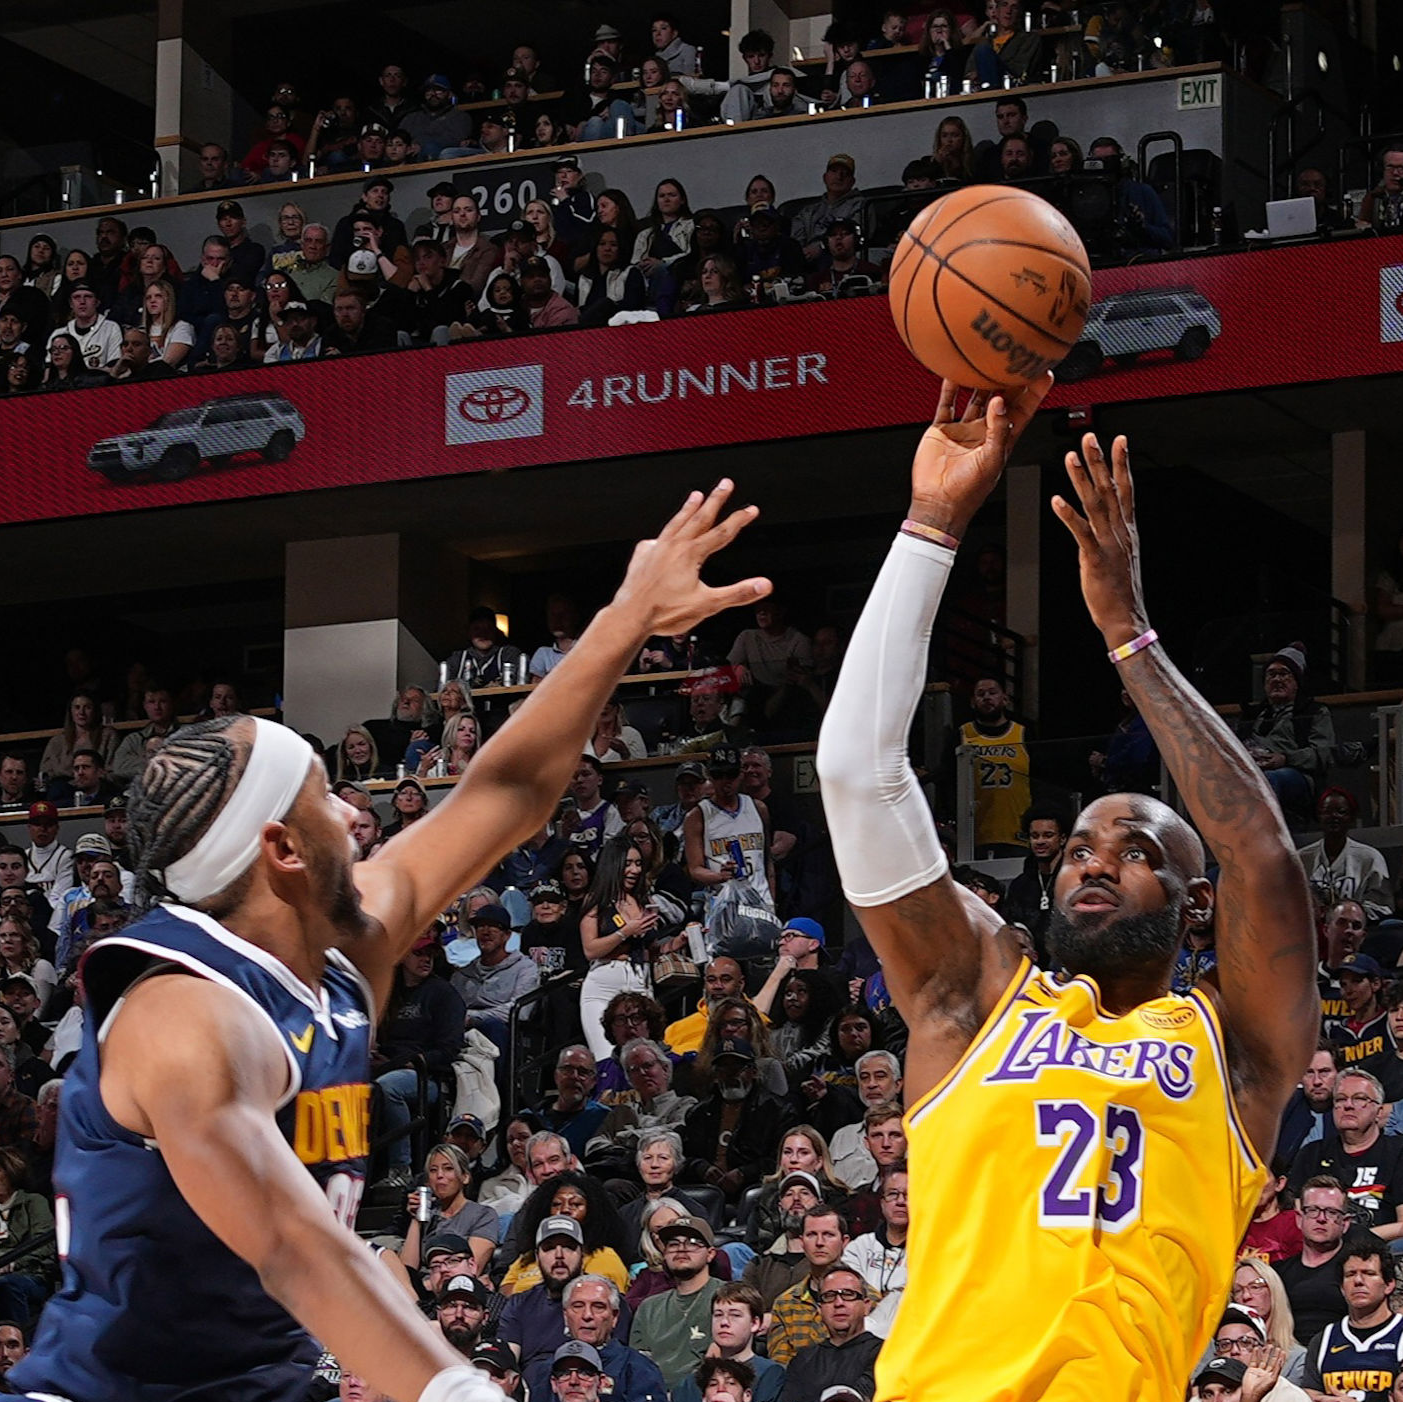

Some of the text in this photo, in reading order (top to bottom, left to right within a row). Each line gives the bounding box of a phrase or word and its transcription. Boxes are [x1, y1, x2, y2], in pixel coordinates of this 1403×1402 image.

[1181, 79, 1218, 106] EXIT
[470, 177, 538, 218] 260
[566, 351, 830, 411] 4RUNNER
[984, 1008, 1197, 1101] LAKERS
[1035, 1099, 1146, 1235] 23
[1322, 1369, 1395, 1395] DENVER
